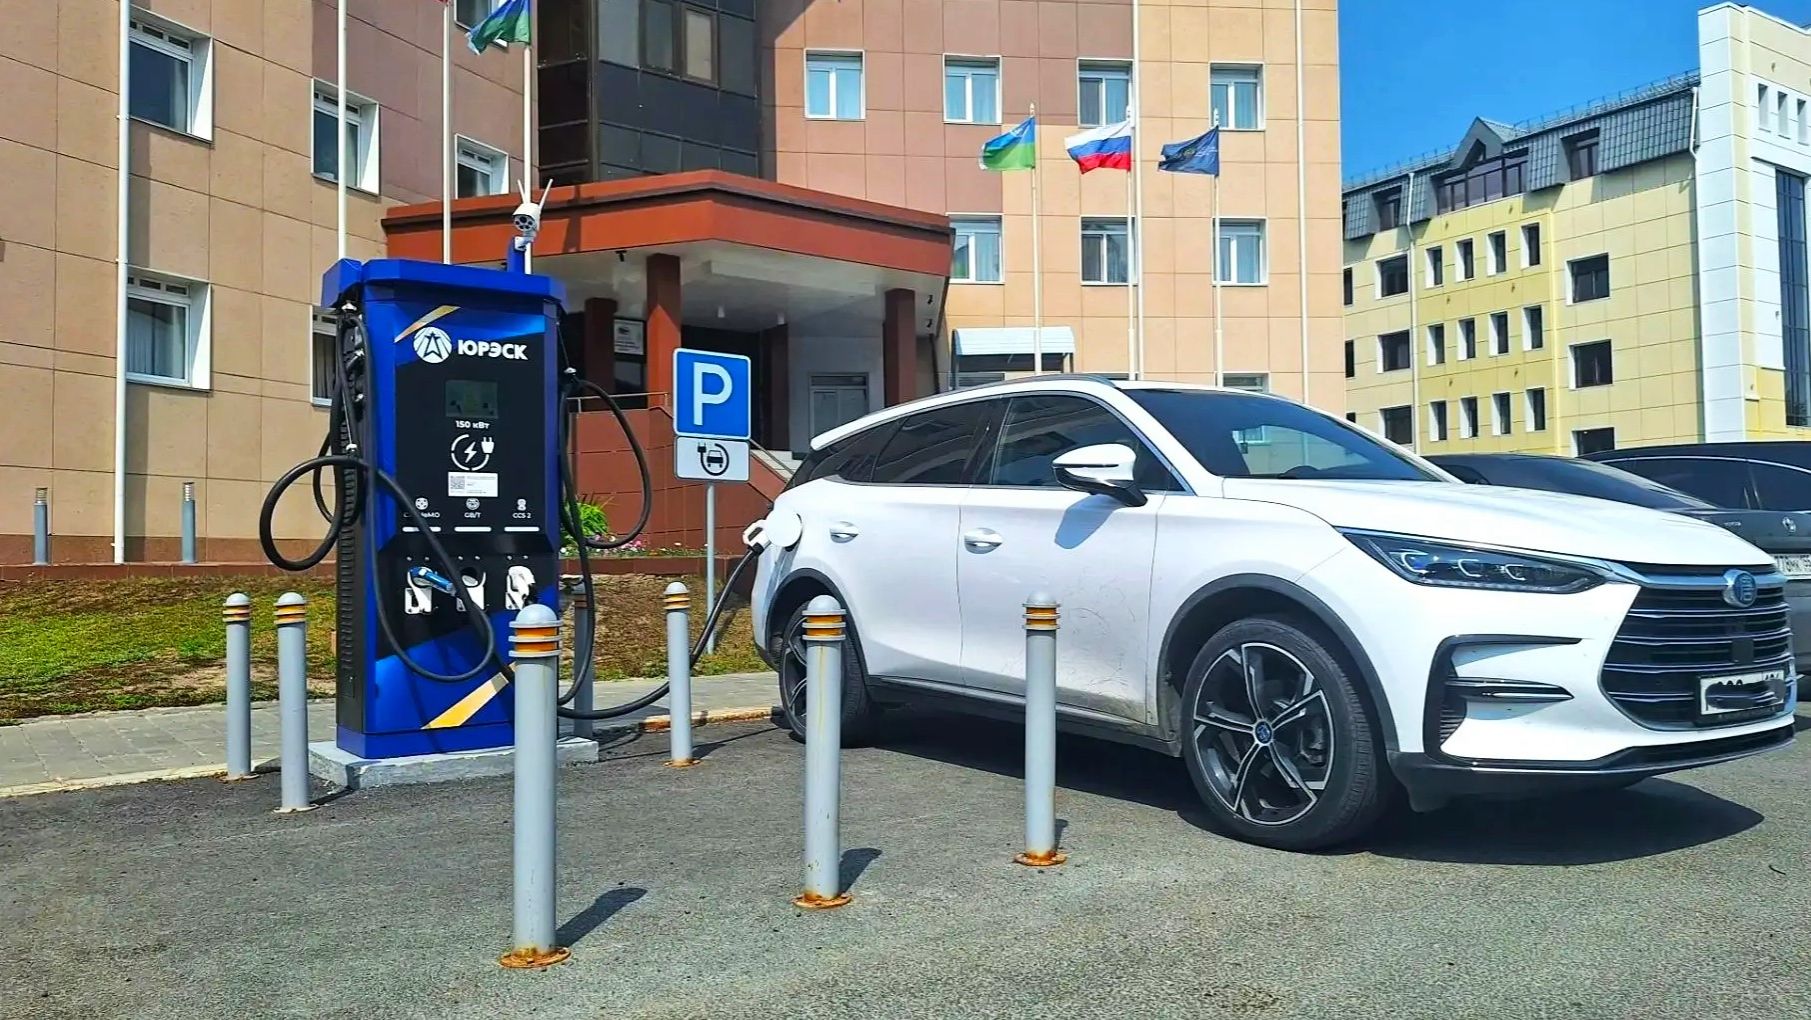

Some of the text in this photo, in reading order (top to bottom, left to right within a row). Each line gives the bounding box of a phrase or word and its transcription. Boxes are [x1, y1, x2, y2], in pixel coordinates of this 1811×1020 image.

[457, 340, 529, 360] ЮРЭСК
[693, 361, 733, 426] P
[455, 420, 490, 430] 150 кВт
[464, 511, 482, 519] GB/T
